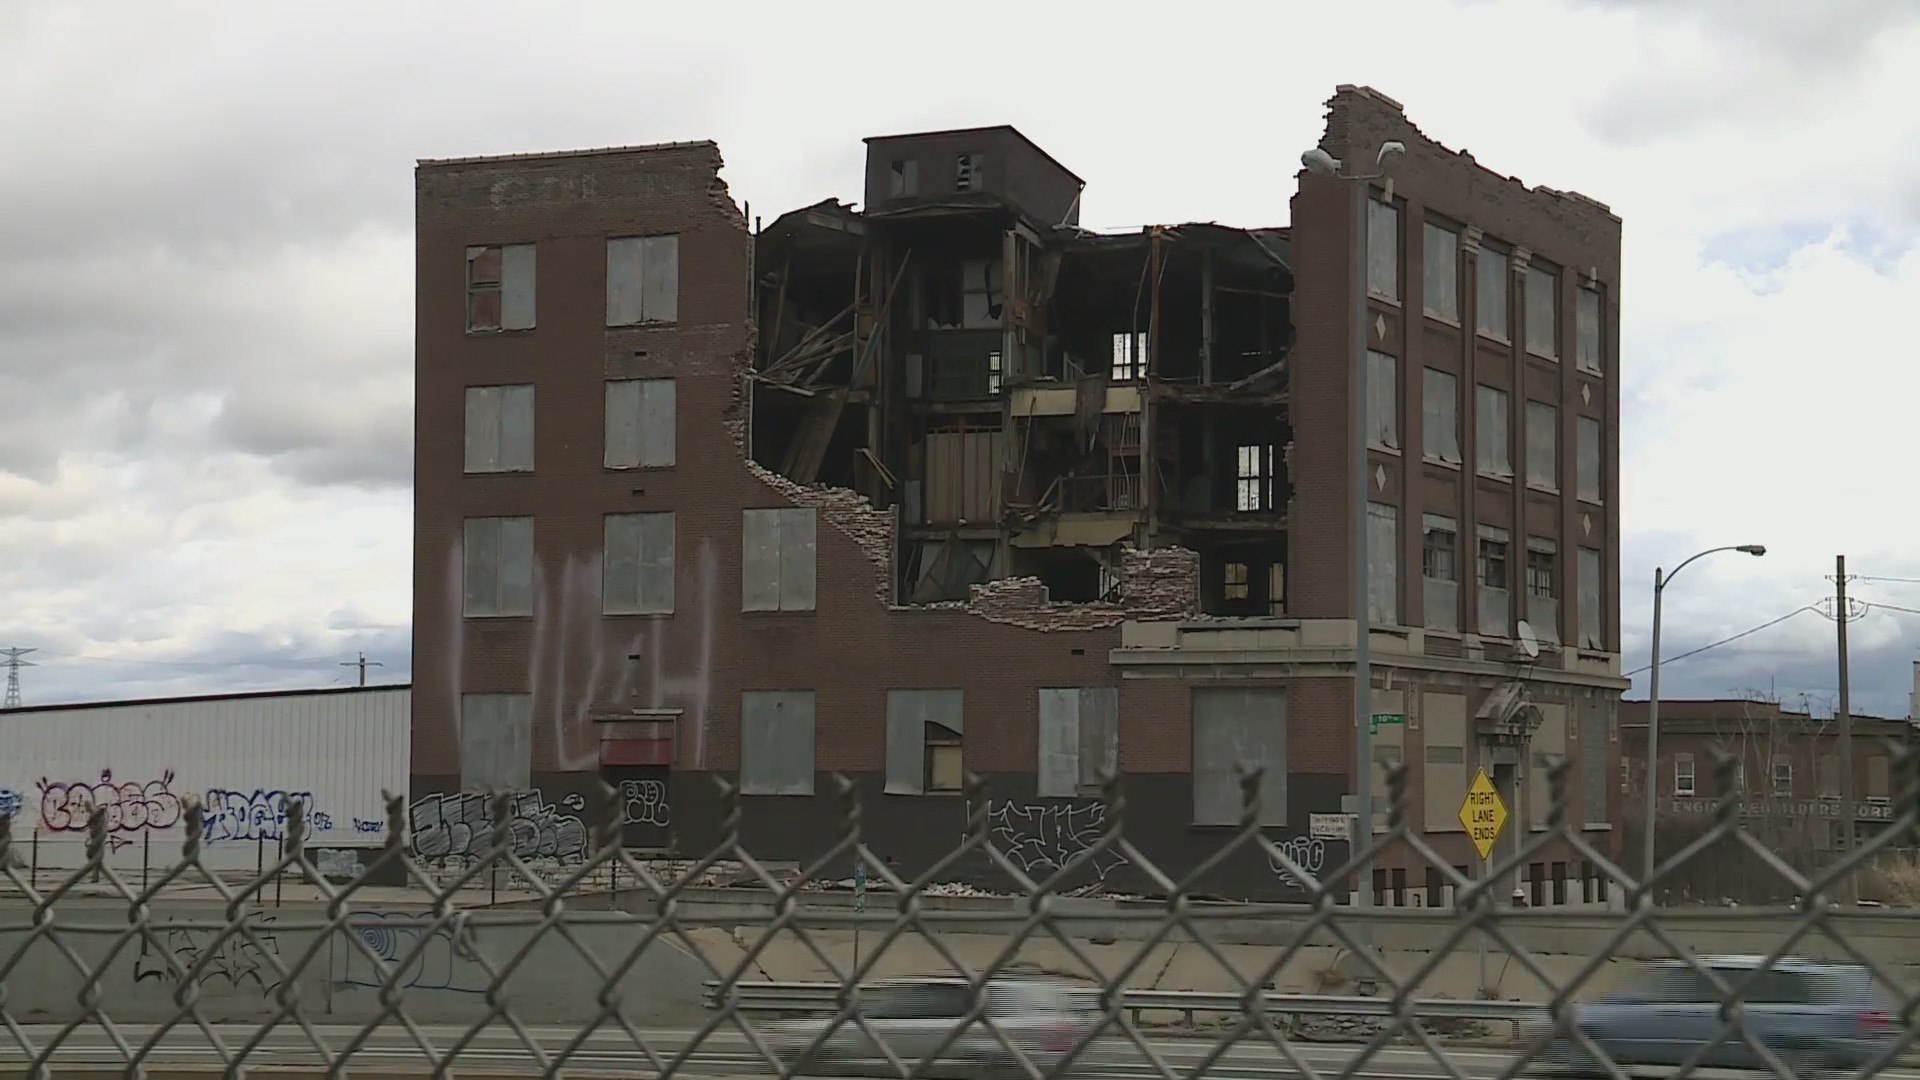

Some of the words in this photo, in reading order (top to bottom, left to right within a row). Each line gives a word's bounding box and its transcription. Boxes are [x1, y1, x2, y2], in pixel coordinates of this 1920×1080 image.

[1470, 792, 1495, 805] RIGHT
[1472, 809, 1495, 823] LANE
[1672, 800, 1723, 814] ENGIN
[1852, 805, 1894, 818] ORP
[1474, 827, 1496, 841] ENDS
